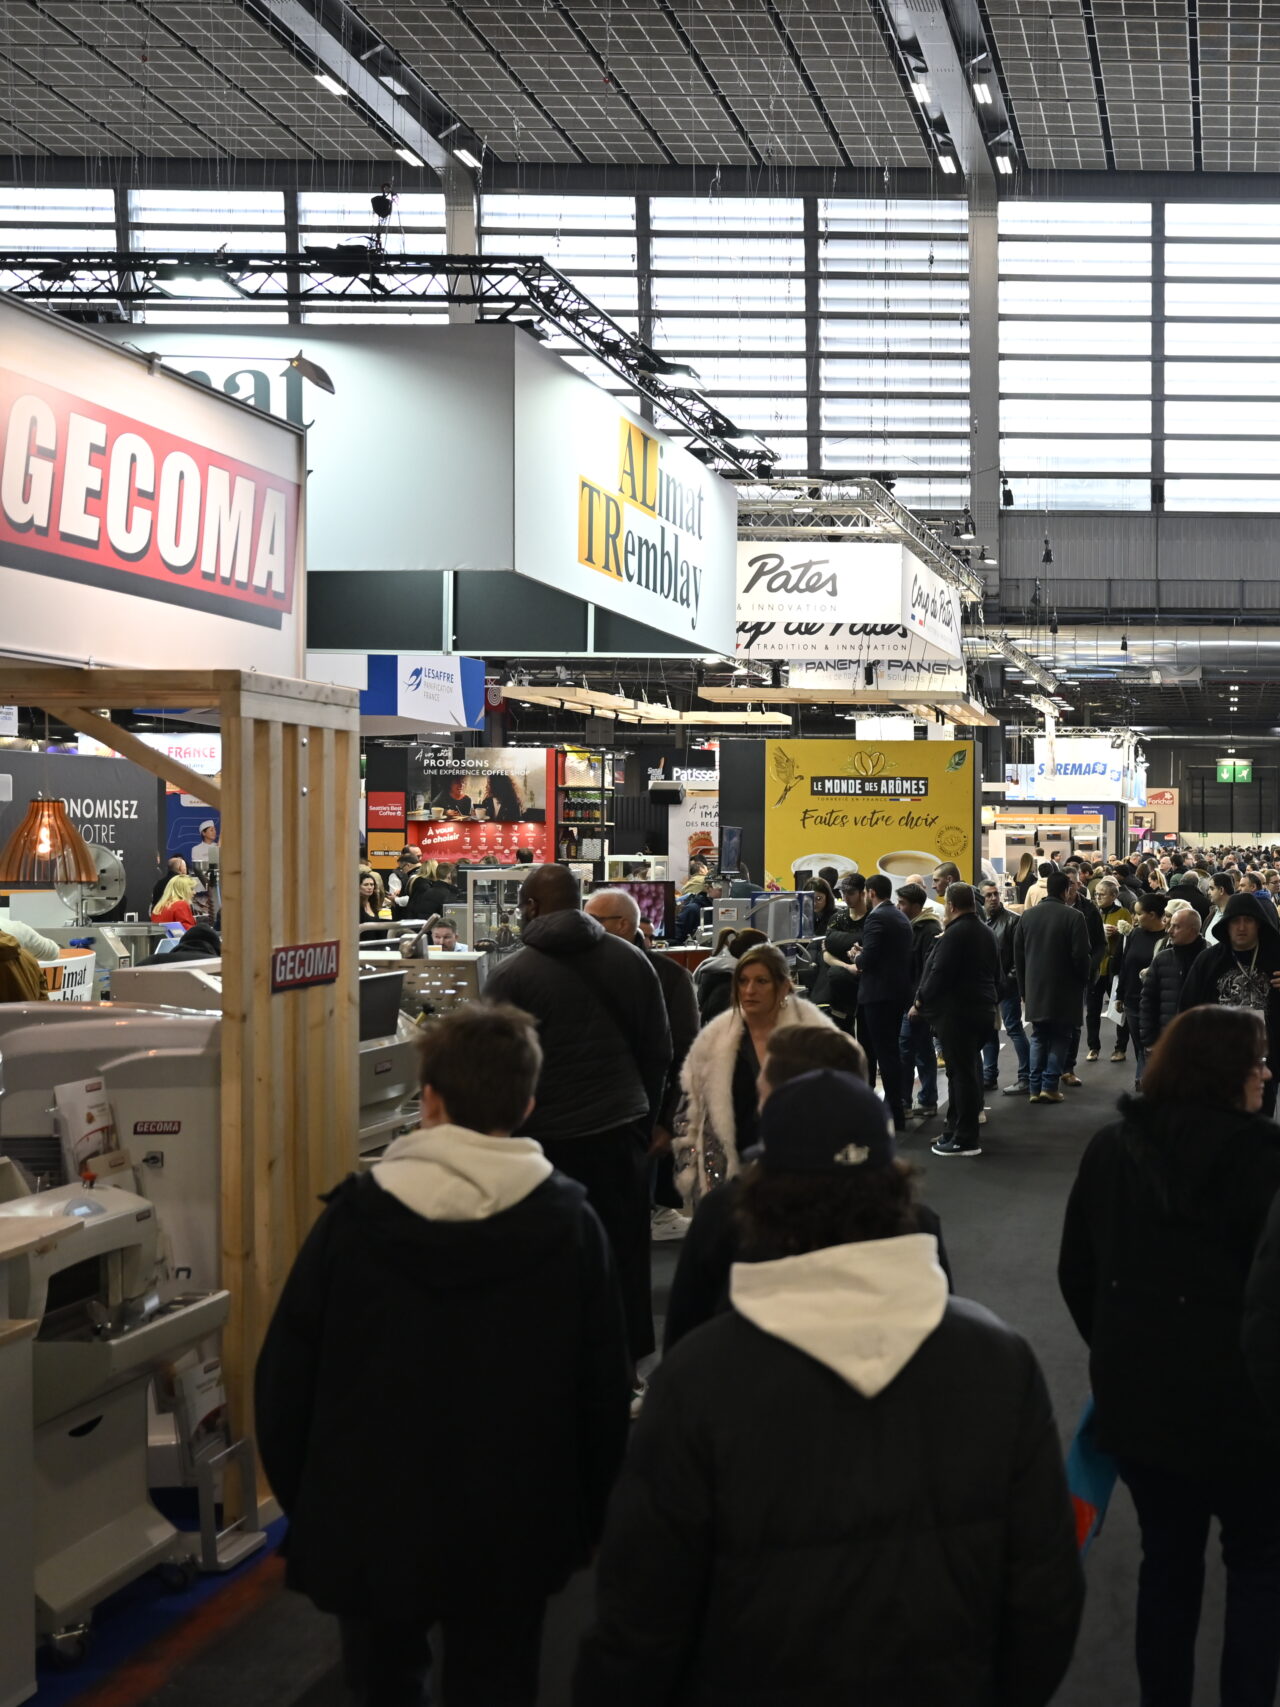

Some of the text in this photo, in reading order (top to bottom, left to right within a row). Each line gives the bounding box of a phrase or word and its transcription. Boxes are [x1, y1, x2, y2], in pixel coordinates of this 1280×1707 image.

[618, 424, 704, 541] ALimat
[1, 394, 288, 597] GECOMA
[581, 480, 702, 631] TRemblay
[742, 553, 838, 597] Pates
[752, 603, 837, 612] INNOVATION
[757, 643, 907, 651] TRADITION & INNOVATION
[424, 667, 455, 684] LESAFFRE
[805, 659, 964, 676] PANEM PANEM
[167, 746, 216, 759] FRANCE
[423, 760, 489, 768] PROPOSONS
[440, 767, 480, 776] EXPÉRIENCE
[813, 777, 925, 794] LE MONDE DES ARÔMES
[801, 809, 940, 829] Faites votre choix
[427, 827, 435, 836] À
[433, 833, 460, 844] choisir
[276, 945, 337, 983] GECOMA
[137, 1121, 180, 1132] GECOMA
